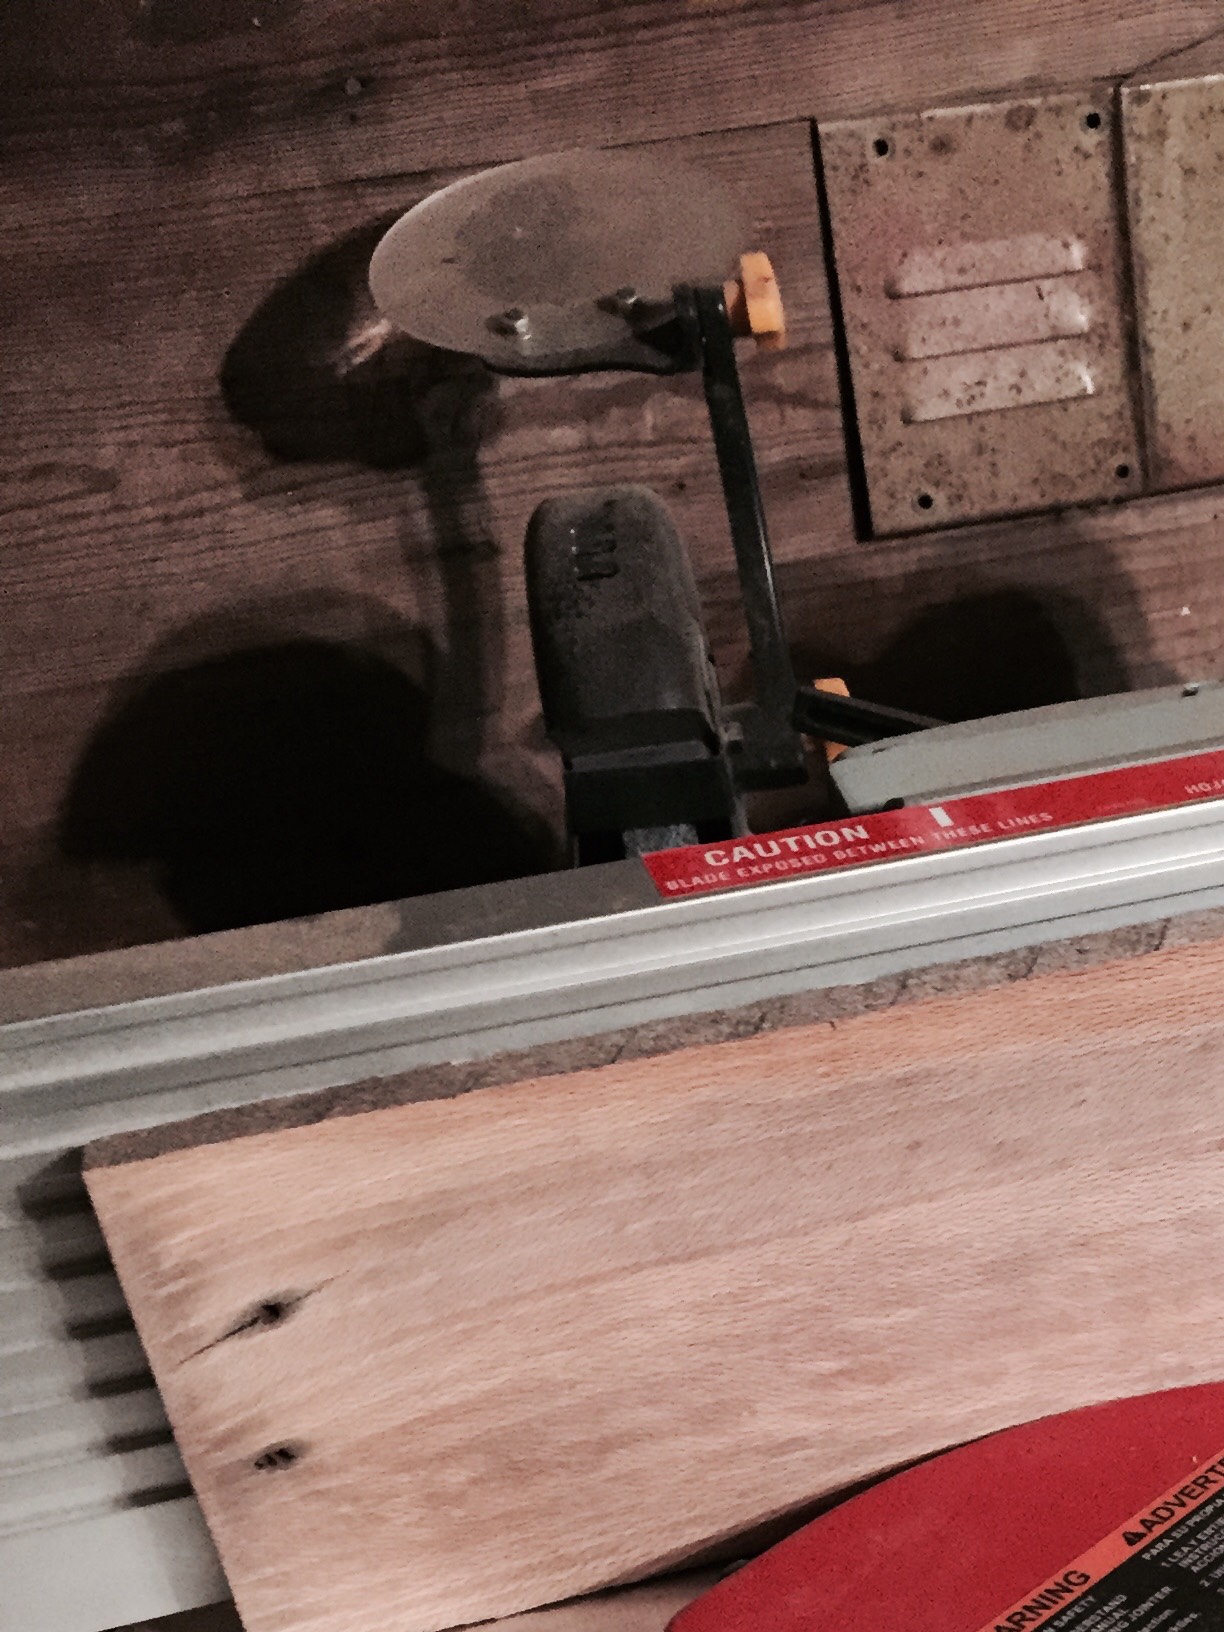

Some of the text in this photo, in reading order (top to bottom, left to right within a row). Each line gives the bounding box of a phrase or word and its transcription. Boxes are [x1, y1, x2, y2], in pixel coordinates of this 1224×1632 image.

[666, 811, 1054, 892] BLADE EXPOSED BETWEEN THESE LINES
[704, 824, 870, 867] CAUTION
[1140, 1537, 1174, 1560] PARA
[1050, 1594, 1099, 1628] SAFETY
